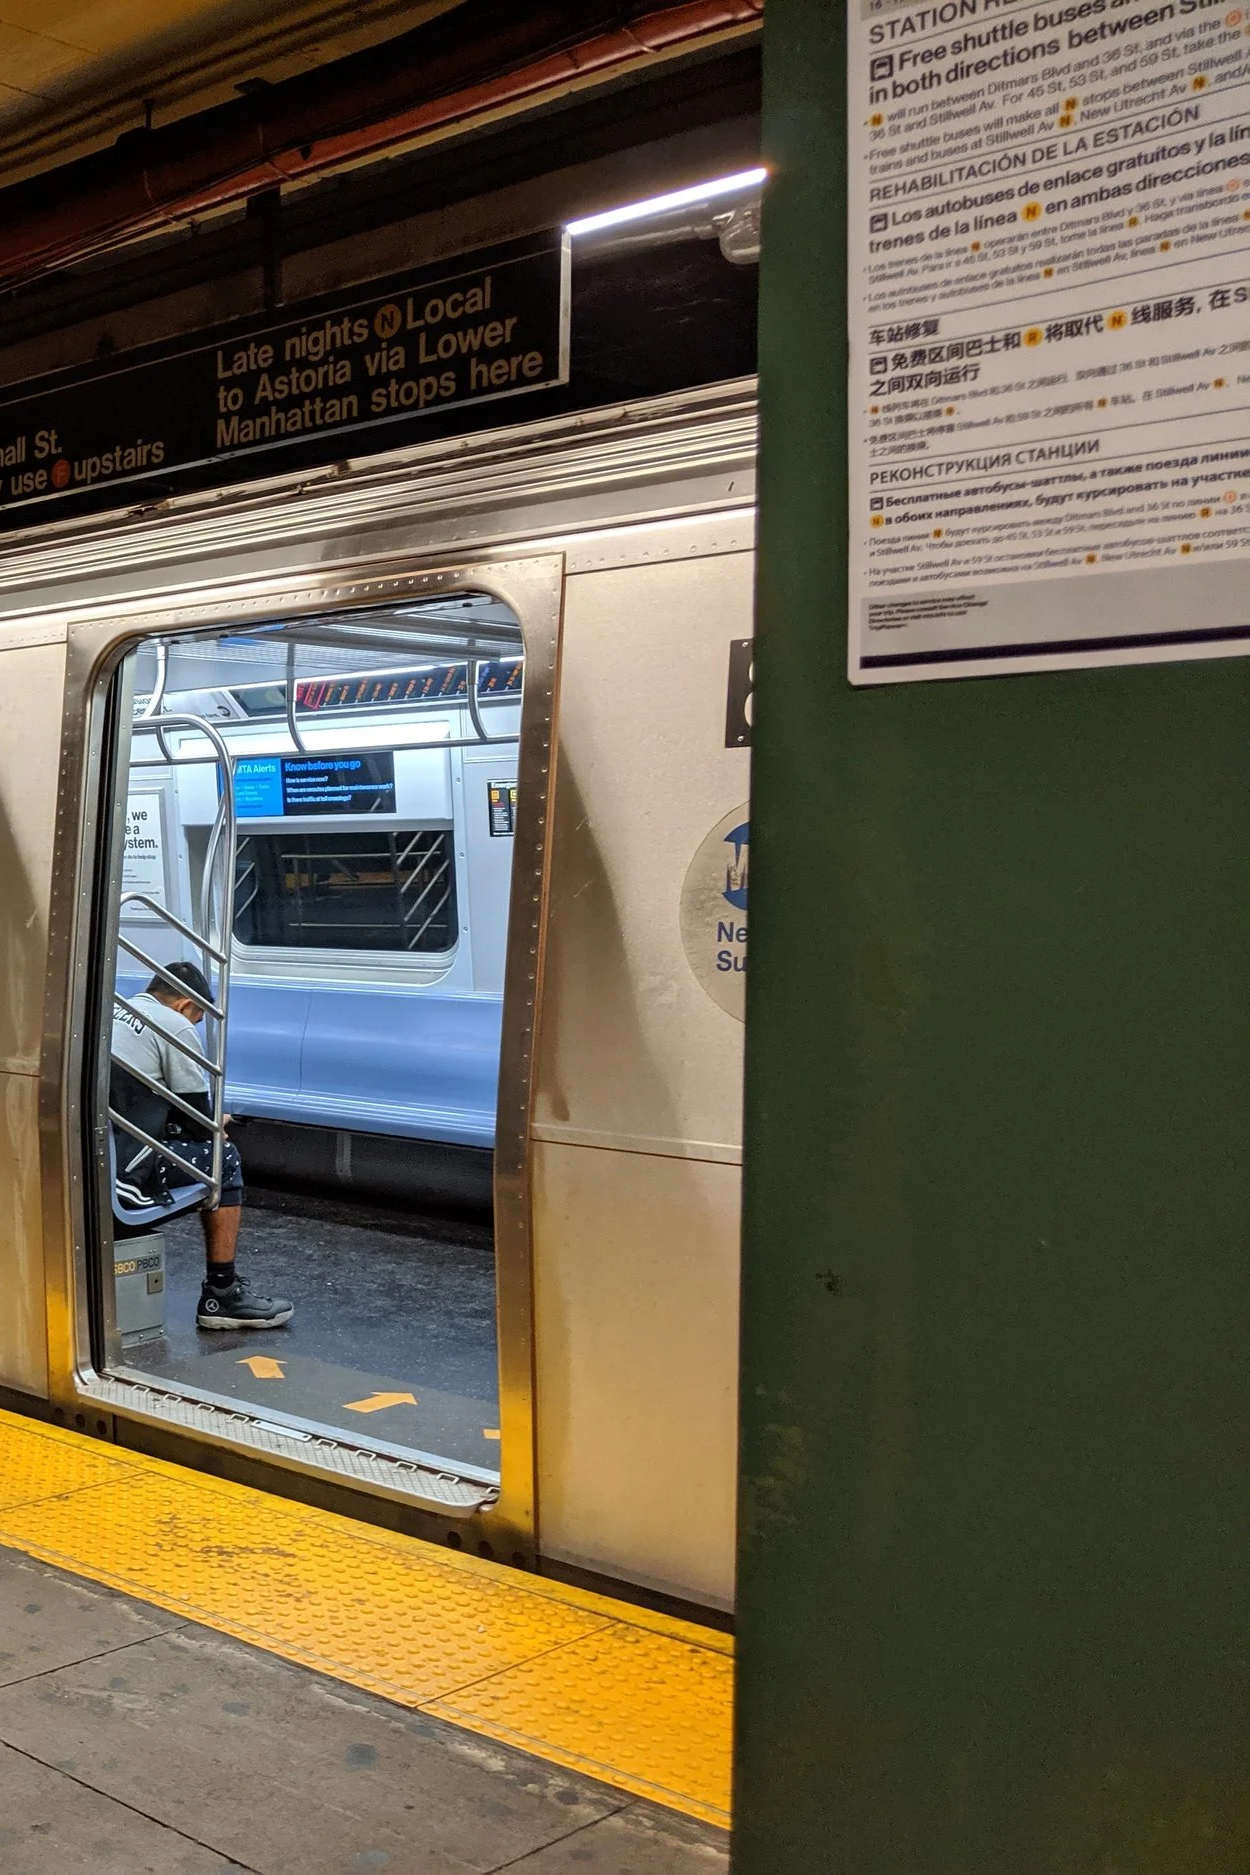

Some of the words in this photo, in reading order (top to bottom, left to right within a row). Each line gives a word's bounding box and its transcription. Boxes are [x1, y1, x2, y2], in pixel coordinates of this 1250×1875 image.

[869, 0, 977, 44] STATION
[899, 45, 946, 70] Free
[951, 20, 1028, 55] shuttle
[1033, 1, 1106, 32] buses
[869, 86, 887, 105] in
[893, 70, 941, 98] both
[945, 39, 1060, 84] directions
[1068, 4, 1174, 49] between
[870, 152, 1026, 201] REHABILITACIÓN
[1031, 145, 1058, 163] DE
[1063, 137, 1088, 156] LA
[1093, 105, 1199, 147] ESTACIÓN
[925, 187, 1014, 217] autobuses
[1043, 167, 1103, 190] enlace
[1107, 142, 1191, 178] gratuitos
[974, 211, 1017, 231] línea
[1045, 199, 1067, 214] en
[1071, 183, 1132, 204] ambas
[218, 343, 273, 379] Late
[286, 318, 369, 361] nights
[407, 276, 491, 329] Local
[218, 385, 243, 413] to
[254, 356, 351, 405] Astoria
[365, 343, 405, 376] via
[420, 317, 517, 364] Lower
[217, 395, 357, 448] Manhattan
[371, 371, 456, 412] stops
[471, 351, 543, 389] here
[11, 469, 48, 496] use
[74, 439, 164, 483] upstairs
[35, 429, 62, 459] St.
[870, 453, 1011, 485] РЕКОНСТРУКЦИЯ
[1015, 439, 1100, 463] СТАНЦИИ
[254, 765, 276, 773] Alerts
[285, 763, 307, 771] Know
[307, 761, 333, 770] before
[334, 762, 349, 771] you
[350, 760, 360, 769] go
[131, 811, 148, 820] we
[134, 825, 139, 834] a
[137, 1257, 159, 1268] PBCO
